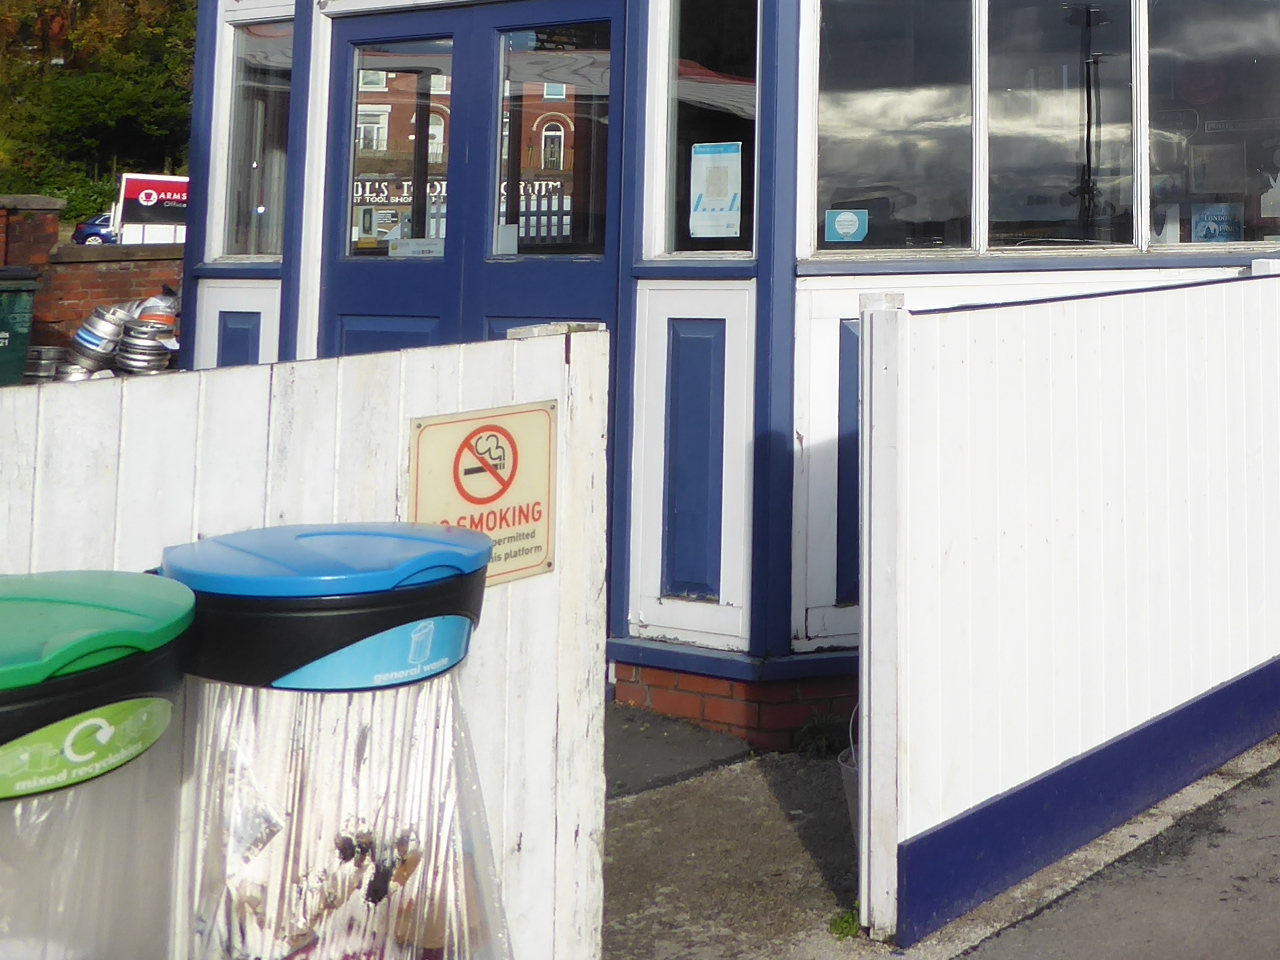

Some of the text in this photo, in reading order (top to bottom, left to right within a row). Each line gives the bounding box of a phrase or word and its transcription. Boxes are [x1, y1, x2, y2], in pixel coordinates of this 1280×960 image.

[159, 191, 187, 201] ARMS
[163, 200, 187, 208] Office
[456, 501, 542, 533] SMOKING
[503, 544, 543, 563] platform
[373, 657, 450, 685] general waste
[14, 769, 68, 791] mixed
